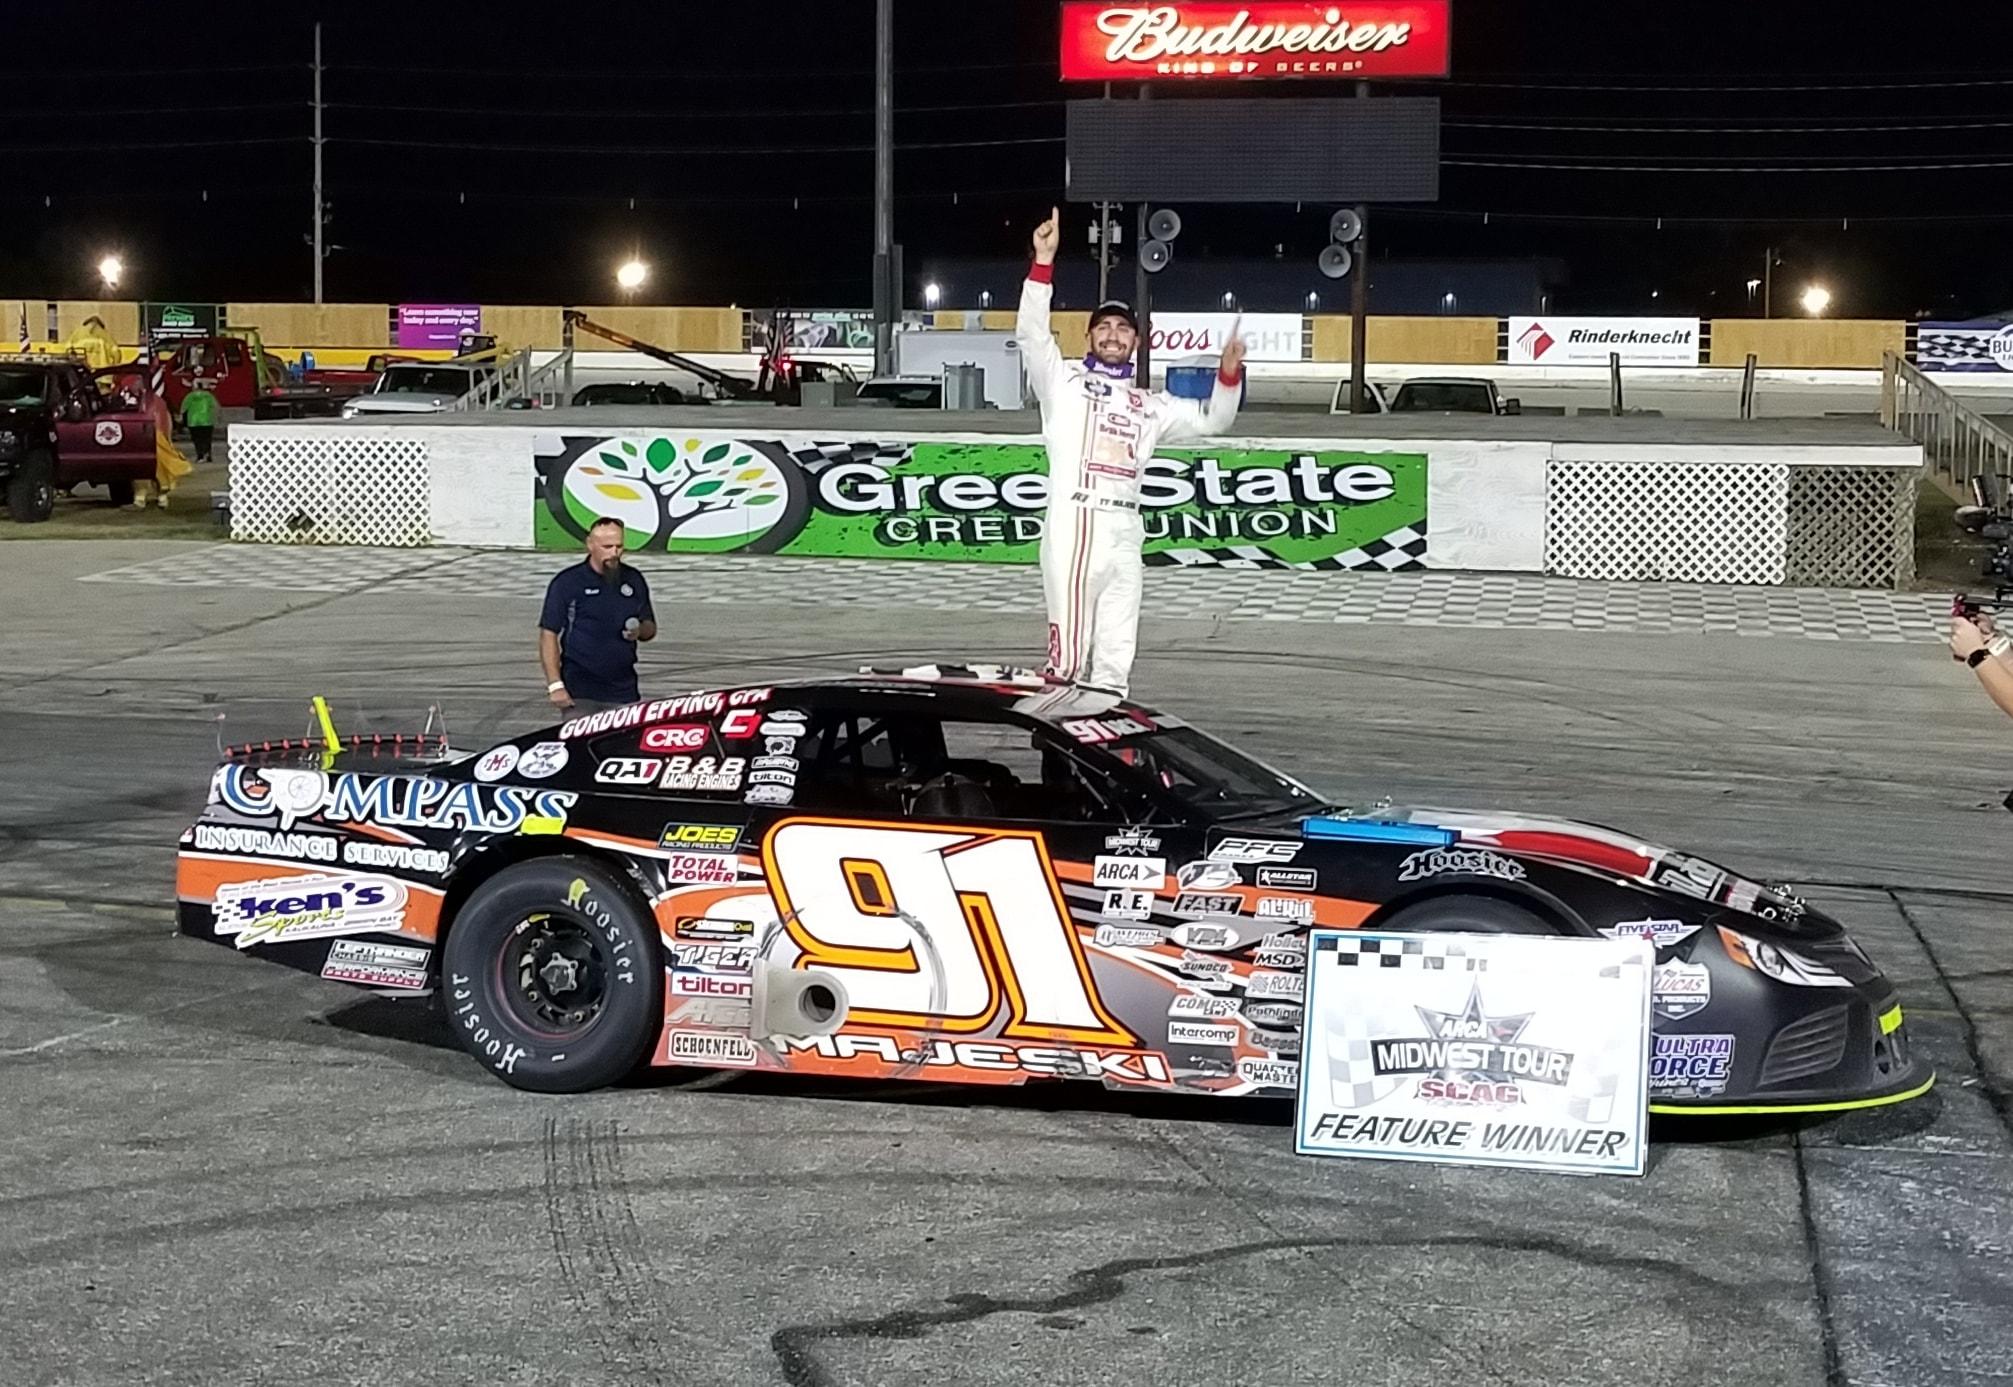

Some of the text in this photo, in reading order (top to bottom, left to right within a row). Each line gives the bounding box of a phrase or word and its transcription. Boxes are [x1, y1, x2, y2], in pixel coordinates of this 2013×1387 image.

[1097, 7, 1412, 62] Budweiser
[1149, 320, 1212, 351] oors
[1567, 329, 1692, 344] Rinderknecht
[818, 463, 1050, 512] Gree
[885, 509, 1336, 541] CRED UNION
[559, 706, 644, 739] GORDON
[645, 728, 705, 748] CRC
[599, 761, 659, 779] QA1
[660, 773, 741, 789] RACING ENGINES
[664, 825, 738, 843] JOES
[196, 824, 450, 874] INSURANCE SERVICES
[671, 855, 728, 871] TOTAL
[1096, 862, 1139, 881] ARCA
[1400, 848, 1527, 881] Hoosier
[671, 869, 736, 882] POWER
[239, 883, 386, 920] ken's
[1178, 896, 1237, 912] FAST
[561, 878, 634, 984] Hoosier
[762, 817, 1147, 1046] 91
[1182, 961, 1229, 972] SUNOCO
[1255, 953, 1295, 966] MSD
[677, 976, 752, 995] tilton
[1653, 979, 1704, 991] LUCAS
[1248, 1007, 1302, 1019] Pathfind
[452, 973, 526, 1074] Hoosier
[1171, 1024, 1236, 1042] Intercomp
[1657, 1038, 1730, 1055] ULTRA
[1243, 1062, 1299, 1075] QUARTE
[1377, 1042, 1569, 1080] MIDWEST TOUR
[1650, 1056, 1728, 1077] ORCE
[1311, 1113, 1627, 1157] FEATURE WINNER
